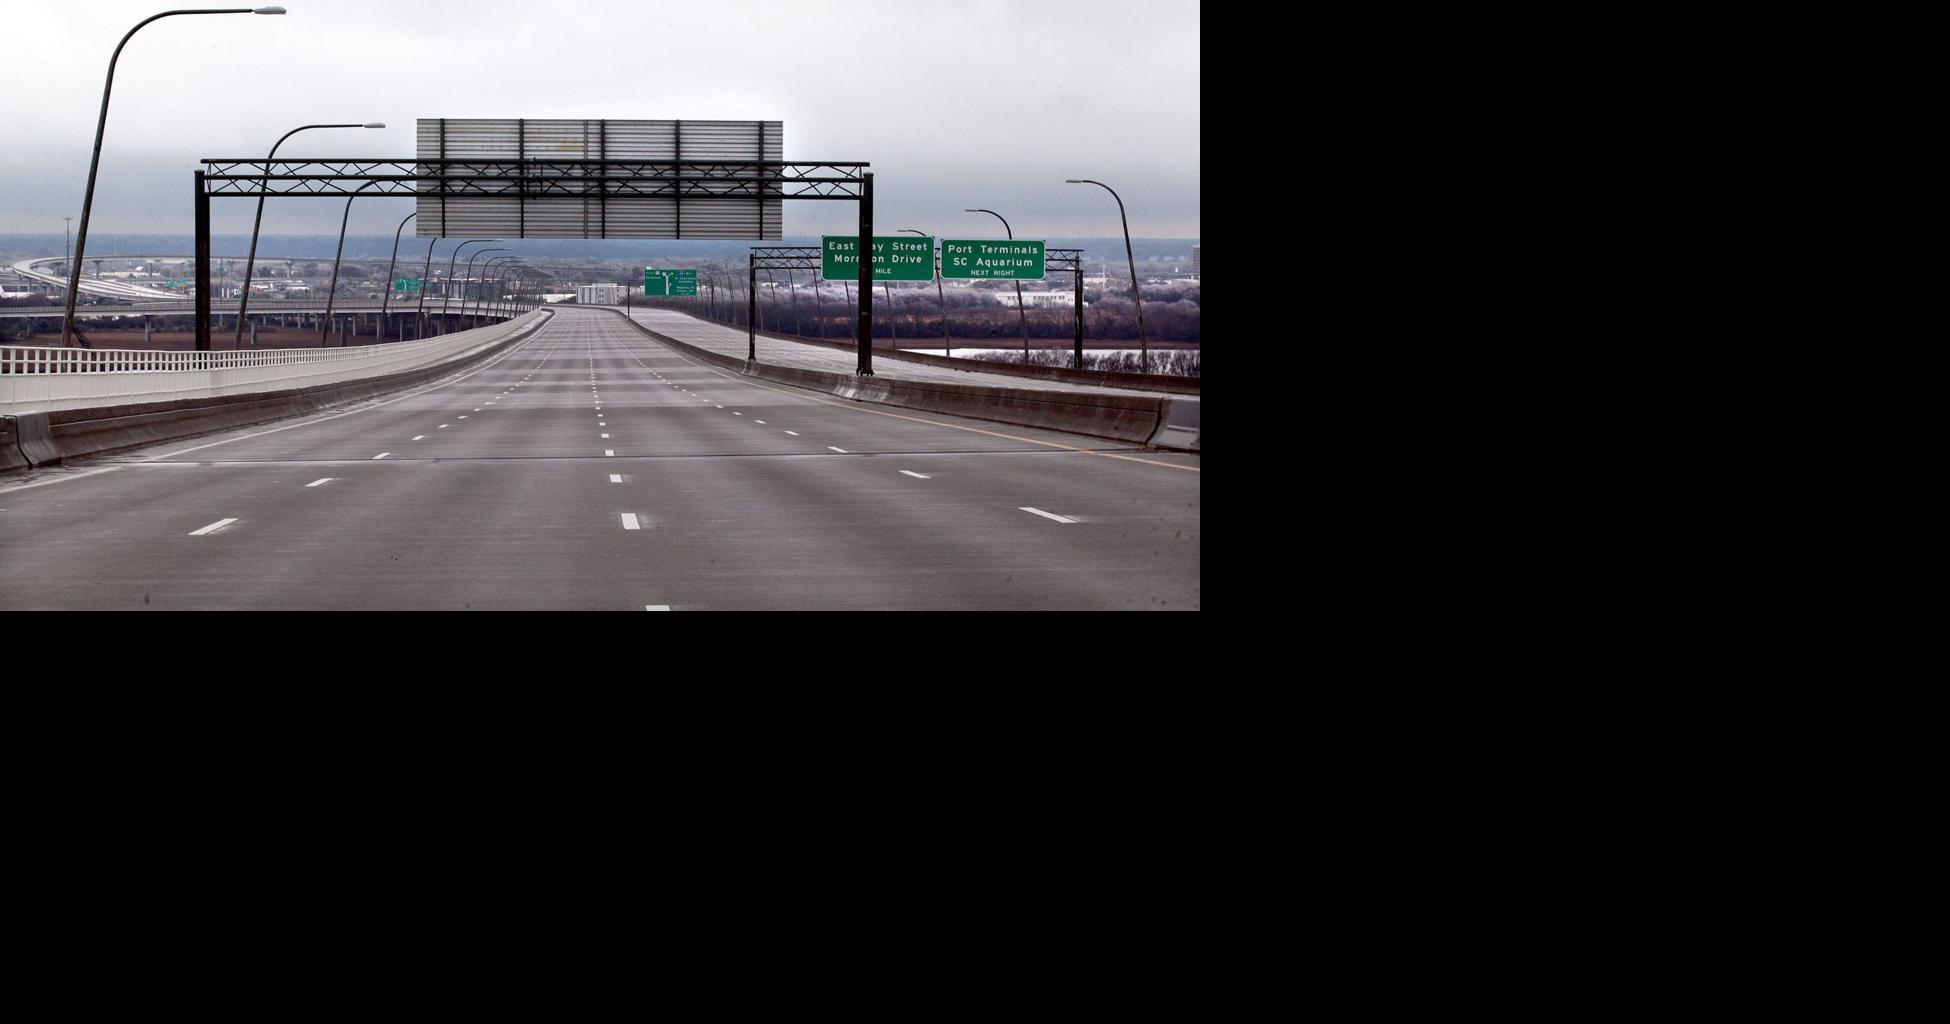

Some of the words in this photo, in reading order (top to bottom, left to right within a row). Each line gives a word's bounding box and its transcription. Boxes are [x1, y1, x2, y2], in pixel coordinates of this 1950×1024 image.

[829, 242, 854, 250] East
[892, 243, 928, 251] Street
[948, 245, 972, 253] Port
[981, 245, 1038, 254] Terminals
[892, 255, 922, 263] Drive
[953, 257, 968, 266] SC
[976, 257, 1033, 268] Aquarium
